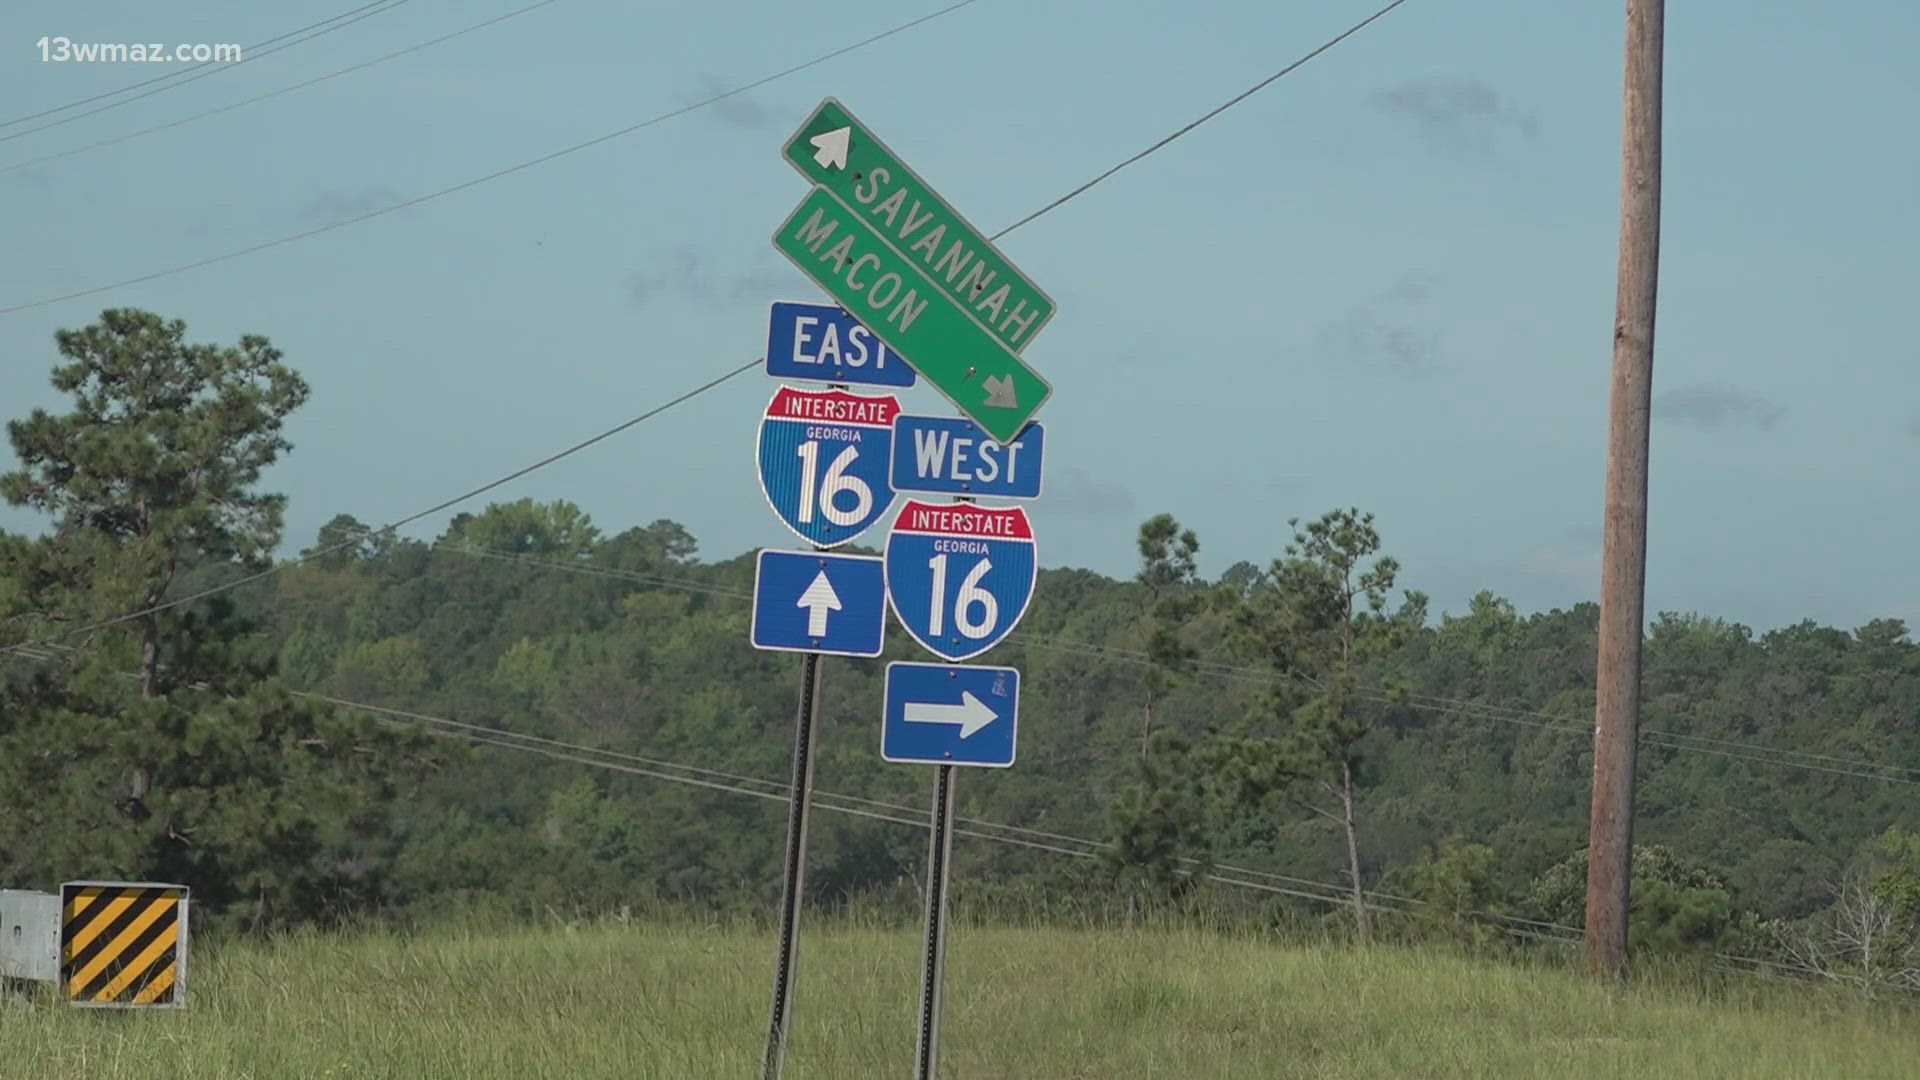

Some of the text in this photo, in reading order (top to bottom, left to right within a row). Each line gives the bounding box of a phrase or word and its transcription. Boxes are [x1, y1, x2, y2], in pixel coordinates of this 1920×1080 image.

[794, 206, 929, 333] MACON
[854, 167, 1040, 343] SAVANNAH
[785, 396, 888, 423] INTERSTATE
[806, 426, 862, 442] GEORGIA
[797, 440, 873, 527] 16
[914, 428, 1024, 484] WEST
[912, 509, 1015, 535] INTERSTATE
[934, 539, 990, 555] GEORGIA
[928, 553, 998, 640] 16
